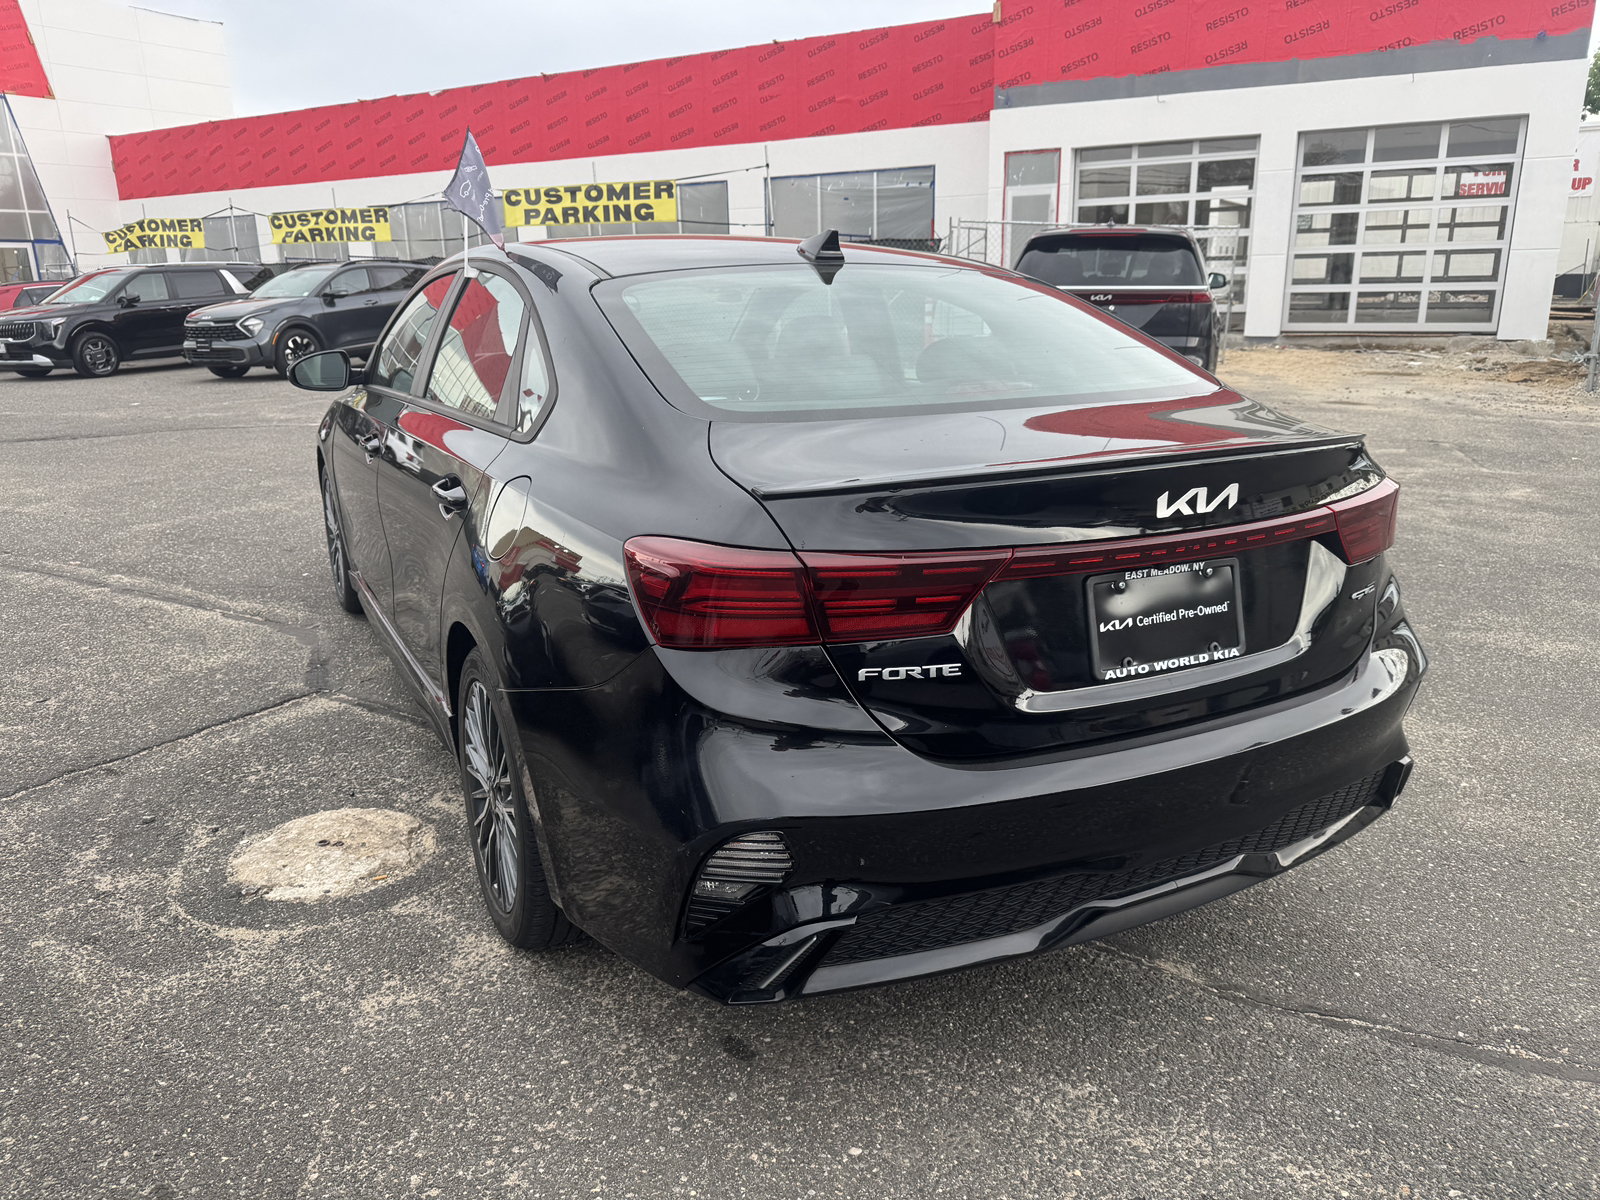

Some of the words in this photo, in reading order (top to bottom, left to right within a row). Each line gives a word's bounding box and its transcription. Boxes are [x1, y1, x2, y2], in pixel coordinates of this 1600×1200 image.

[998, 6, 1034, 29] RESISTO
[1205, 7, 1250, 32] RESISTO
[913, 23, 945, 43] RESISTO
[1064, 16, 1103, 39] RESISTO
[1284, 19, 1330, 44] RESISTO
[1453, 15, 1506, 40] RESISTO
[807, 39, 836, 58] RESISTO
[859, 31, 889, 50] RESISTO
[998, 36, 1035, 58] RESISTO
[1130, 31, 1171, 55] RESISTO
[758, 45, 785, 63] RESISTO
[1205, 40, 1249, 64] RESISTO
[858, 62, 888, 81] RESISTO
[912, 54, 944, 74] RESISTO
[1061, 52, 1099, 74] RESISTO
[667, 75, 692, 92] RESISTO
[712, 69, 738, 86] RESISTO
[758, 73, 785, 91] RESISTO
[806, 69, 835, 87] RESISTO
[585, 86, 607, 102] RESISTO
[625, 80, 649, 97] RESISTO
[912, 82, 944, 101] RESISTO
[546, 90, 567, 106] RESISTO
[712, 97, 738, 114] RESISTO
[808, 95, 836, 113] RESISTO
[859, 89, 889, 107] RESISTO
[586, 112, 608, 127] RESISTO
[626, 107, 649, 123] RESISTO
[668, 103, 693, 119] RESISTO
[547, 115, 568, 130] RESISTO
[714, 122, 739, 138] RESISTO
[759, 115, 786, 132] RESISTO
[588, 134, 610, 150] RESISTO
[628, 130, 652, 146] RESISTO
[670, 126, 695, 142] RESISTO
[549, 138, 570, 153] RESISTO
[1571, 177, 1593, 190] UP
[504, 181, 674, 207] CUSTOMER
[271, 208, 389, 229] CUSTOMER
[524, 203, 655, 225] PARKING
[282, 226, 376, 243] PARKING
[1156, 483, 1240, 518] KIA
[1125, 569, 1149, 580] EAST
[1193, 561, 1205, 571] NY
[1099, 617, 1133, 632] KIA
[1136, 610, 1178, 627] Certified
[858, 663, 962, 682] FORTE
[1105, 664, 1150, 680] AUTO
[1154, 652, 1209, 671] WORLD
[1213, 647, 1240, 661] KIA
